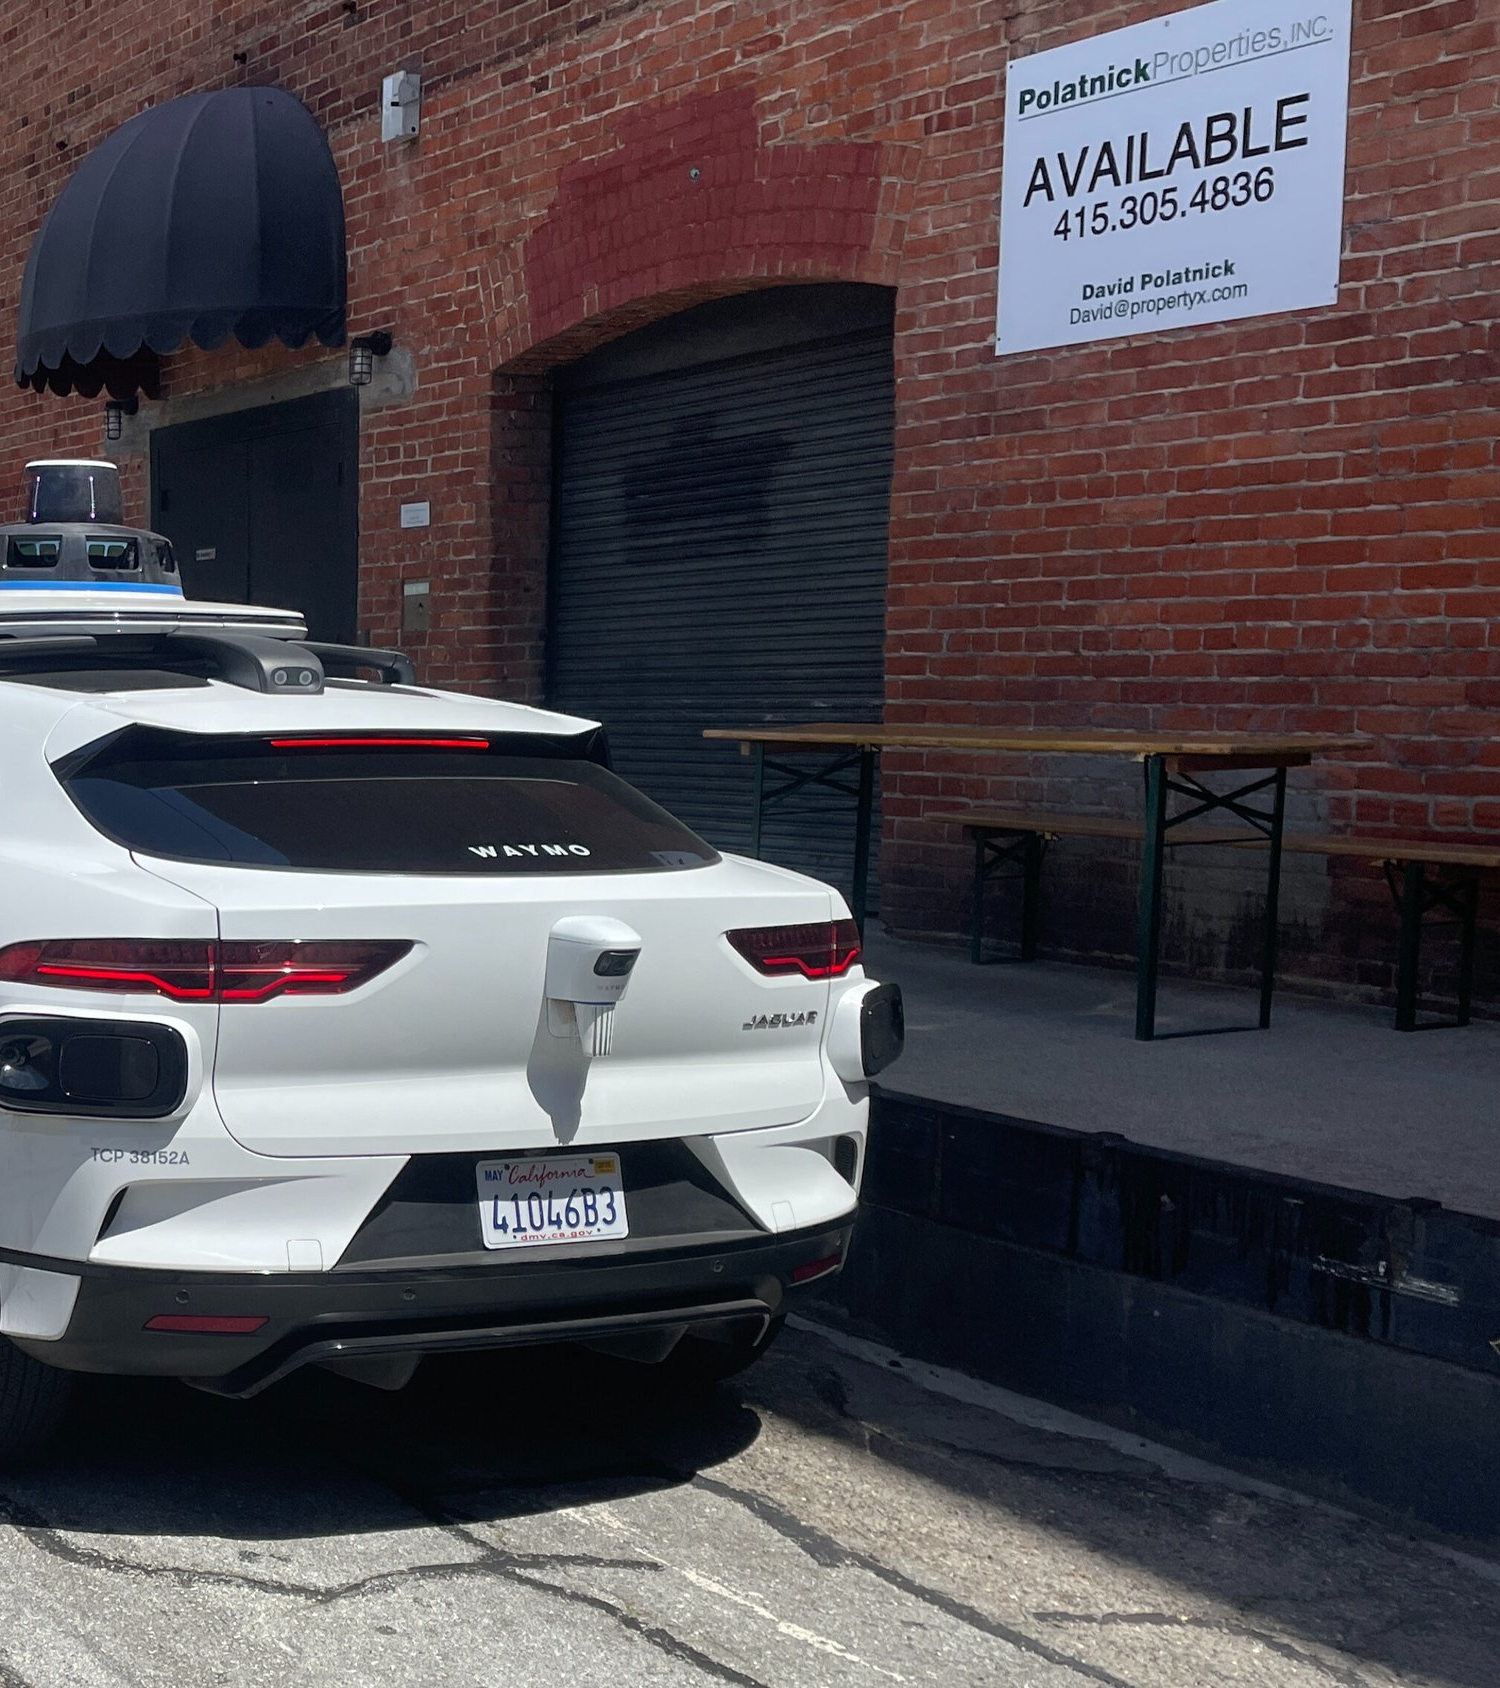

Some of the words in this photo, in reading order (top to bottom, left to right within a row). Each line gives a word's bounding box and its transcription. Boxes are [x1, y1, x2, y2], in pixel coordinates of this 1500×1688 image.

[1023, 92, 1311, 208] AVAILABLE
[1054, 166, 1275, 241] 415.305.4836
[1082, 276, 1134, 300] David
[1140, 259, 1236, 291] Polatnick
[1069, 282, 1248, 325] David@propertyx.com
[468, 844, 591, 858] WAYMO
[742, 1010, 818, 1029] JAGUAR
[90, 1147, 124, 1163] TCP
[129, 1150, 190, 1165] 38152A
[484, 1169, 503, 1182] MAY
[508, 1163, 596, 1189] California
[492, 1186, 617, 1234] 41046B3
[520, 1229, 593, 1242] dmv.ca.gov
